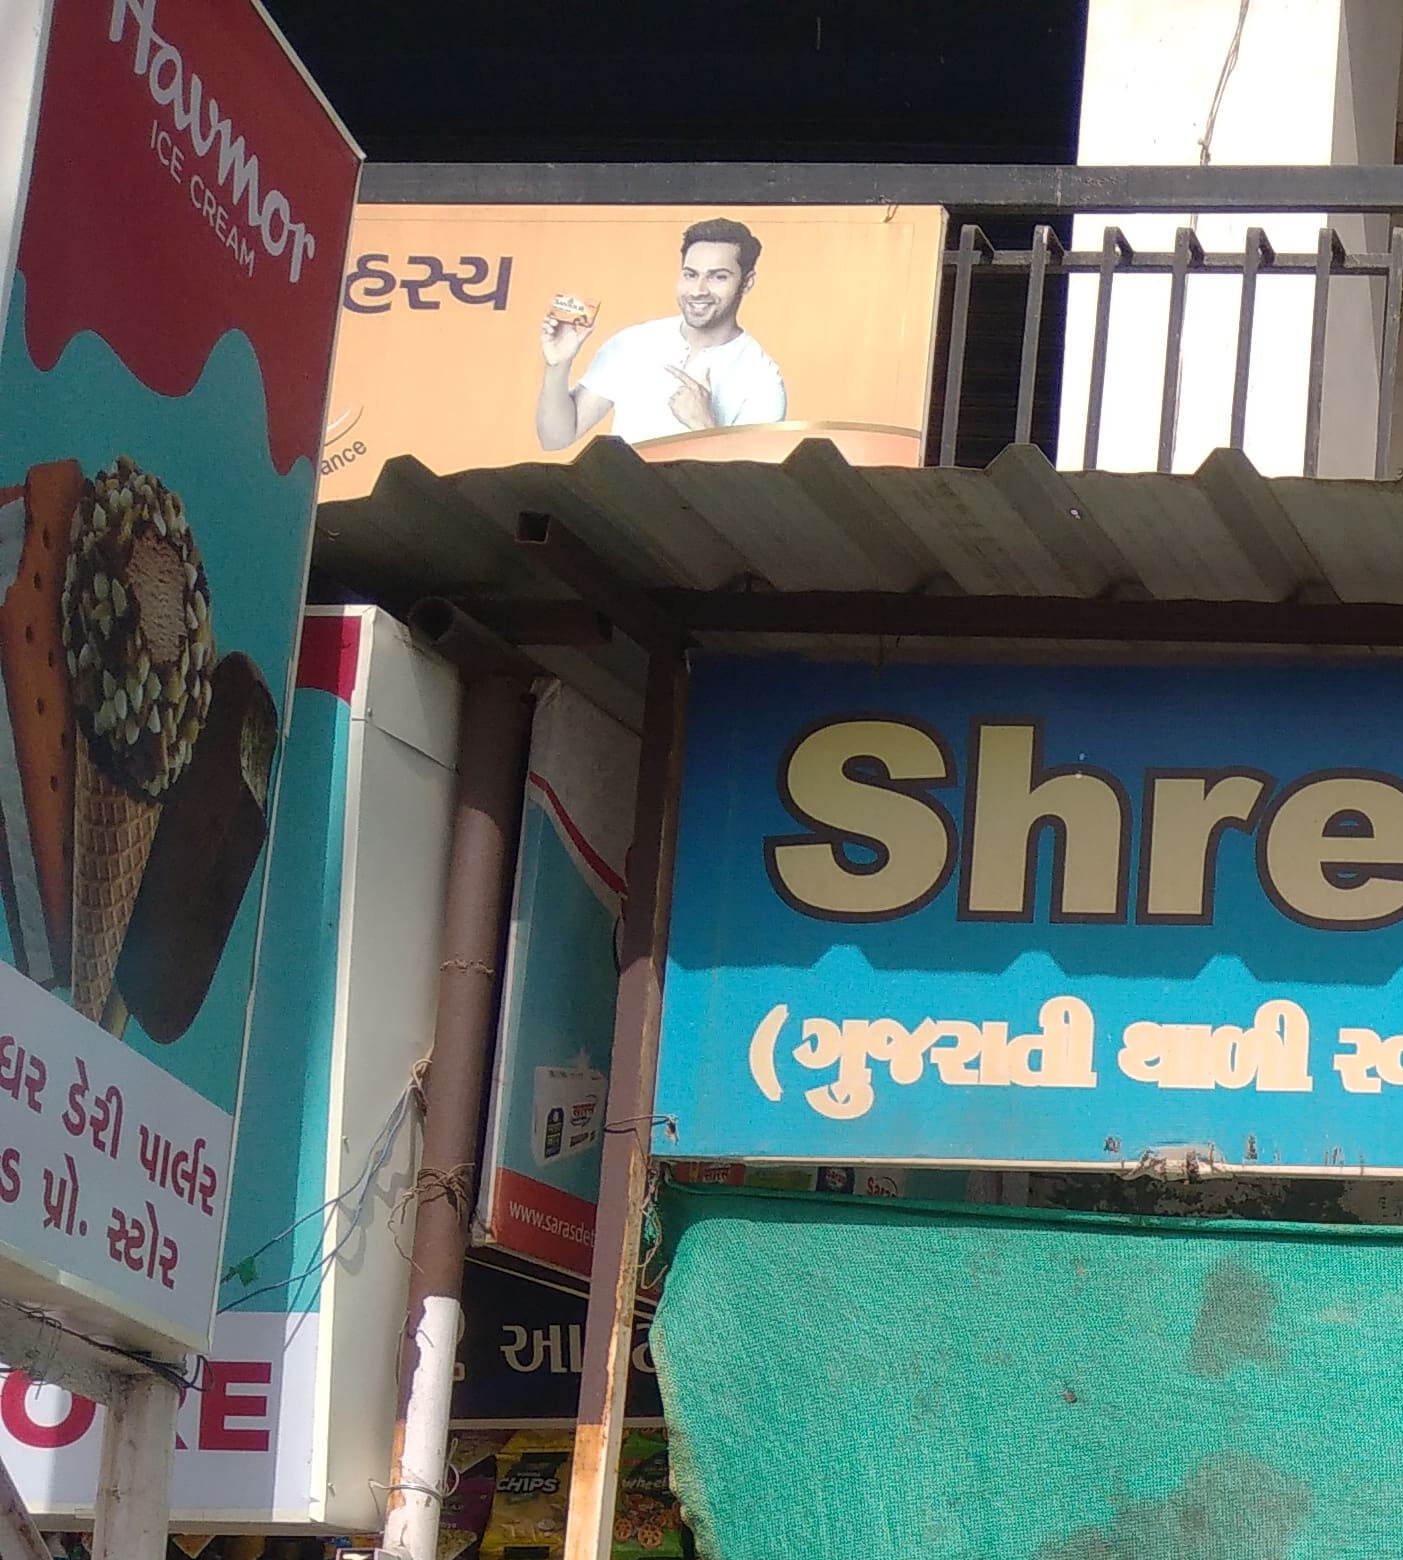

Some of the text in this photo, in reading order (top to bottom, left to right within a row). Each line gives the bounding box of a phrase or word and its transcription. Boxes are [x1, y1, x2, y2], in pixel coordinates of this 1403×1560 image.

[151, 120, 255, 278] ICE CREAM
[1117, 998, 1315, 1093] થાળી
[62, 1056, 124, 1161] ડેરી
[139, 1124, 218, 1217] પાર્લર
[106, 1200, 179, 1290] સ્ટોર
[497, 1477, 558, 1493] CHIPS
